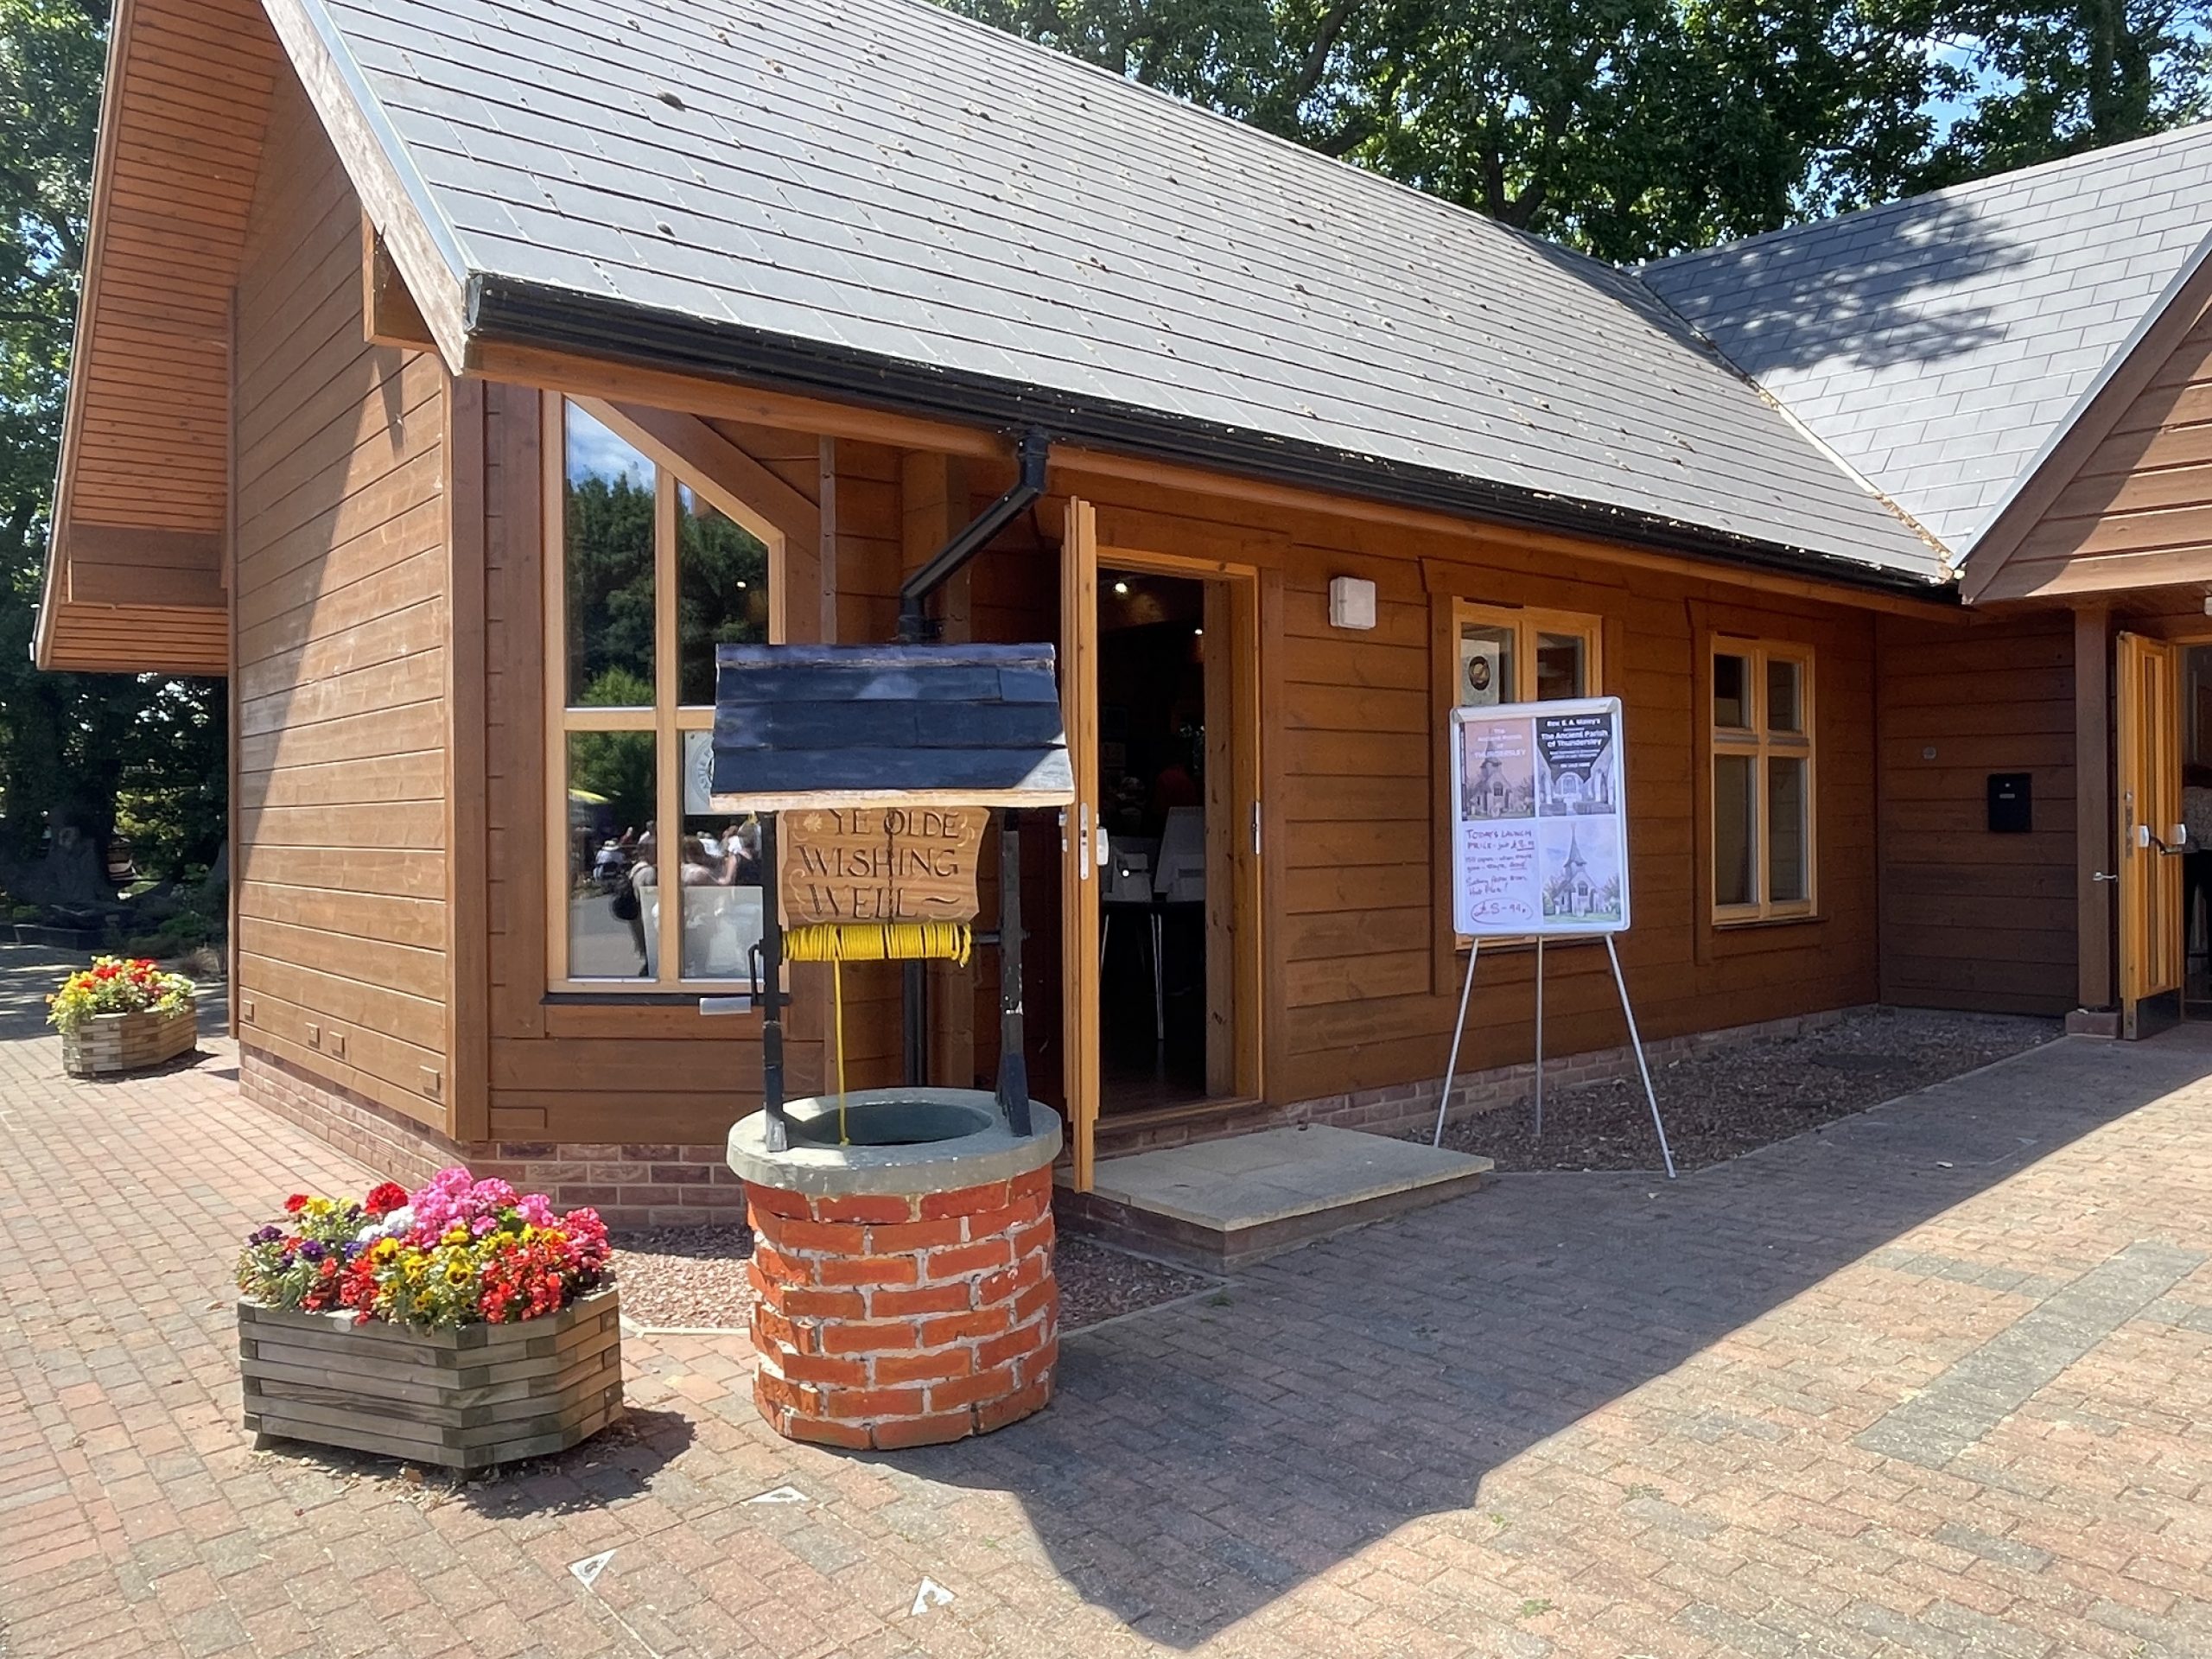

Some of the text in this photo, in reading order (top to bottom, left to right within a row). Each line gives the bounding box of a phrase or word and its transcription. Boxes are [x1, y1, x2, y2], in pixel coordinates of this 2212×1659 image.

[1555, 731, 1584, 740] Ancient
[1584, 729, 1608, 738] Parish
[1556, 738, 1602, 747] Thundersley
[829, 808, 960, 838] YE OLDE
[795, 845, 958, 877] WISHING
[807, 883, 918, 919] WELL
